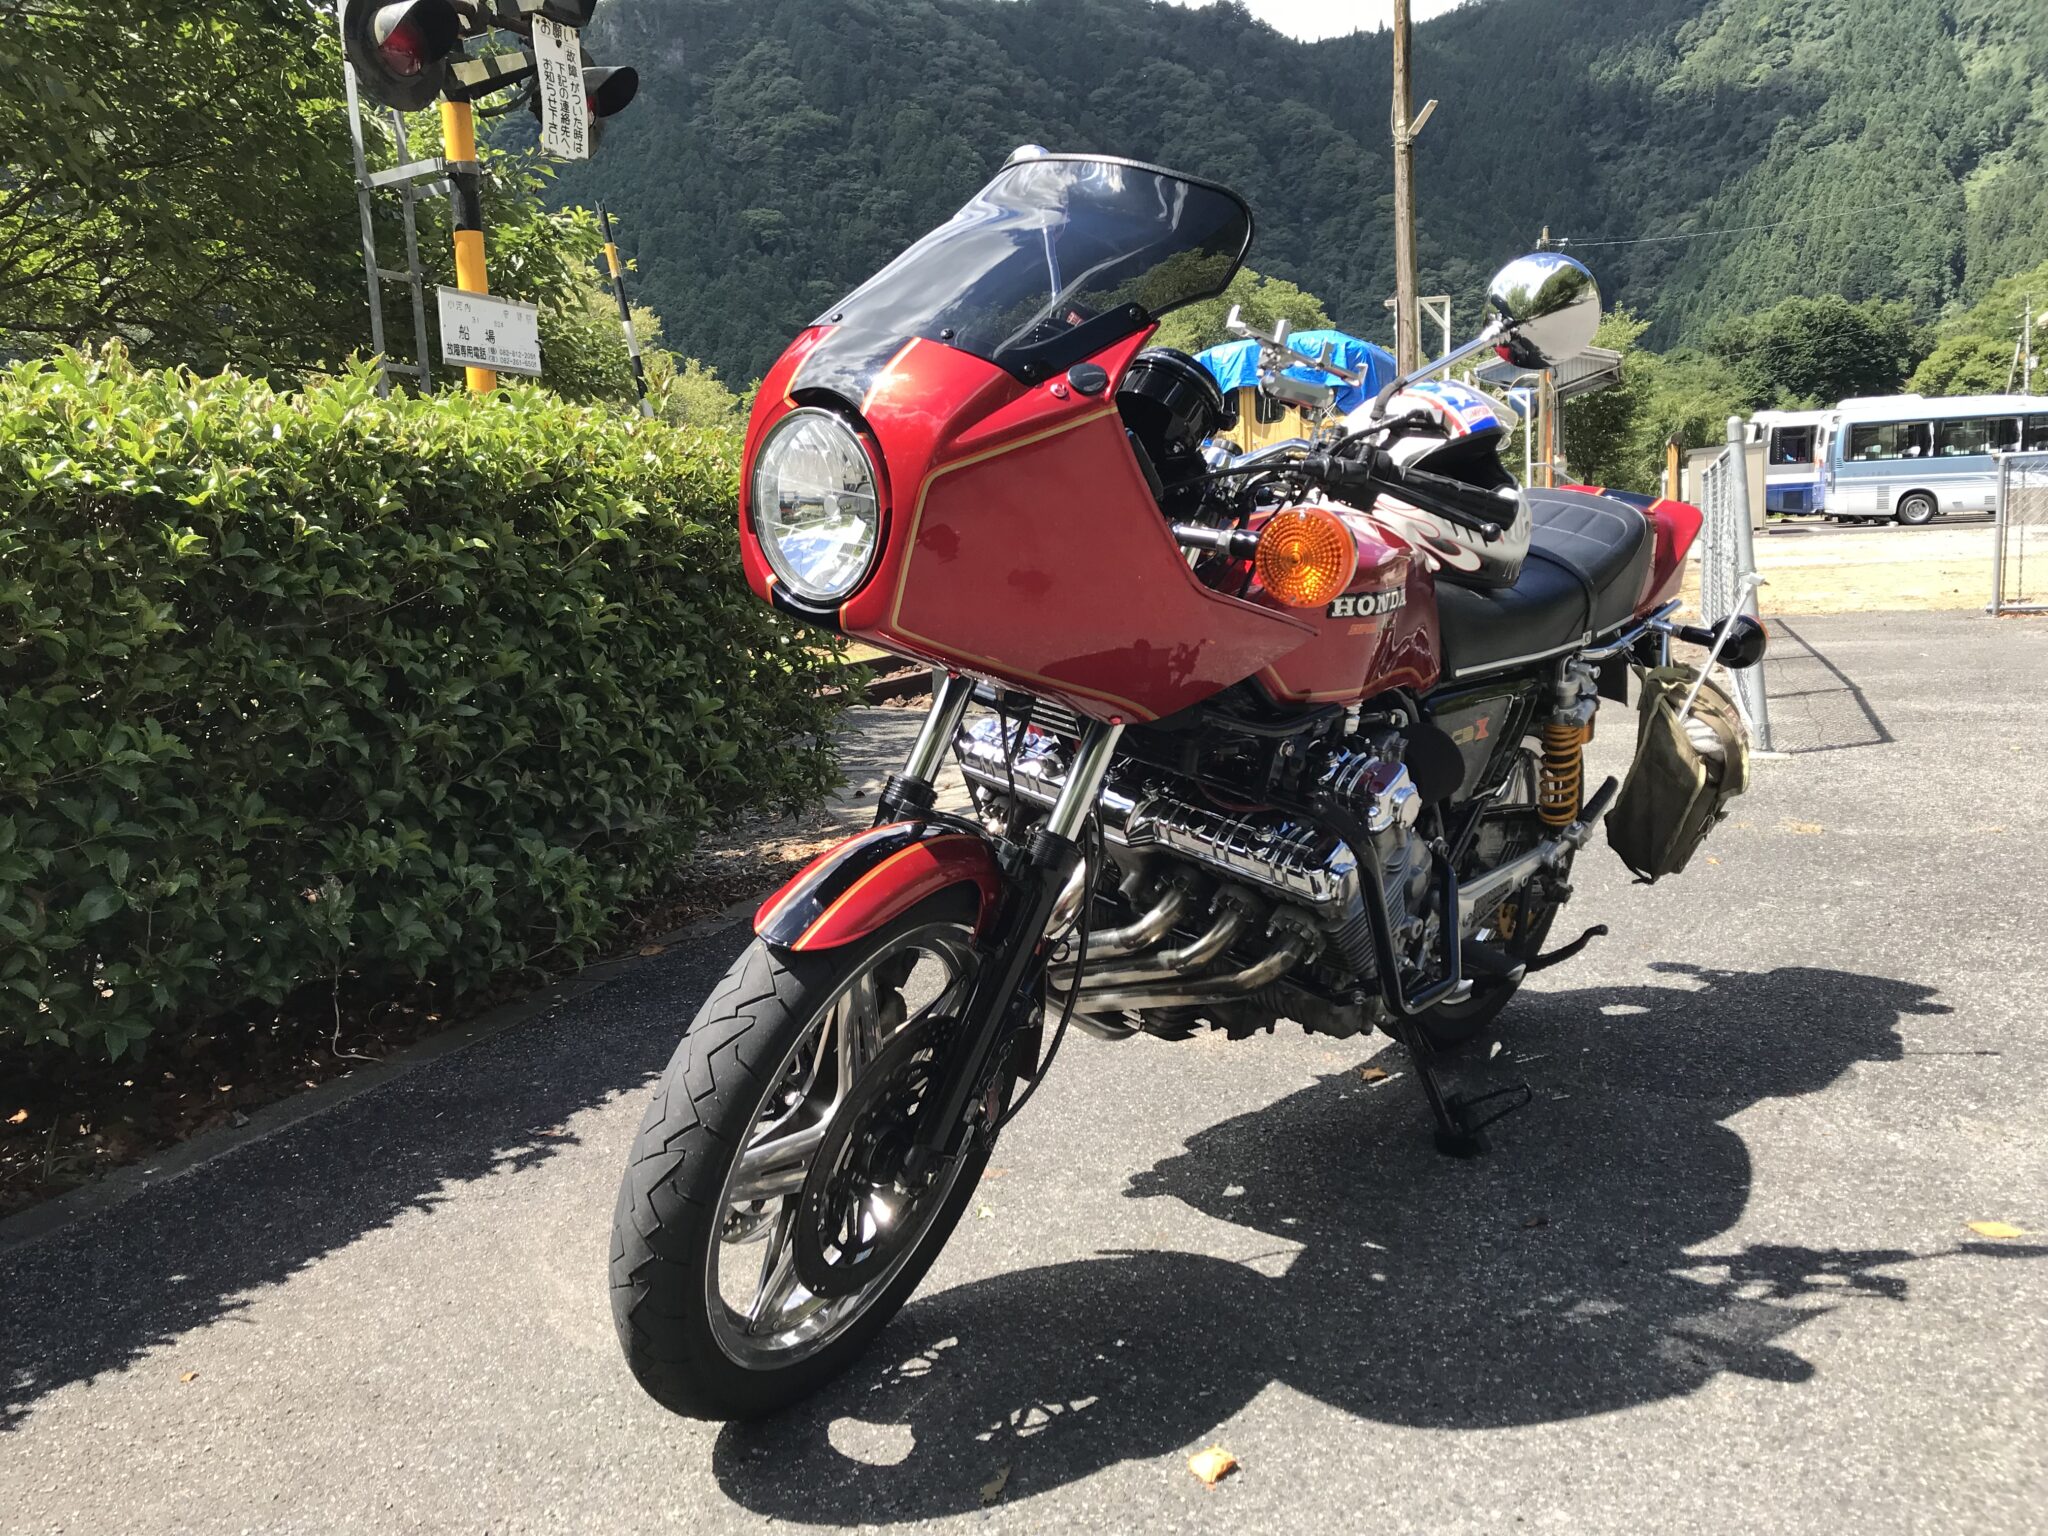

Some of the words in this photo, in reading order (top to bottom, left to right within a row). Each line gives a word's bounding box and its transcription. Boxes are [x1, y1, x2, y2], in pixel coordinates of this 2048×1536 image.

[540, 18, 574, 42] お願い
[543, 57, 559, 145] お知らせ下さい
[1331, 588, 1407, 618] HONDA
